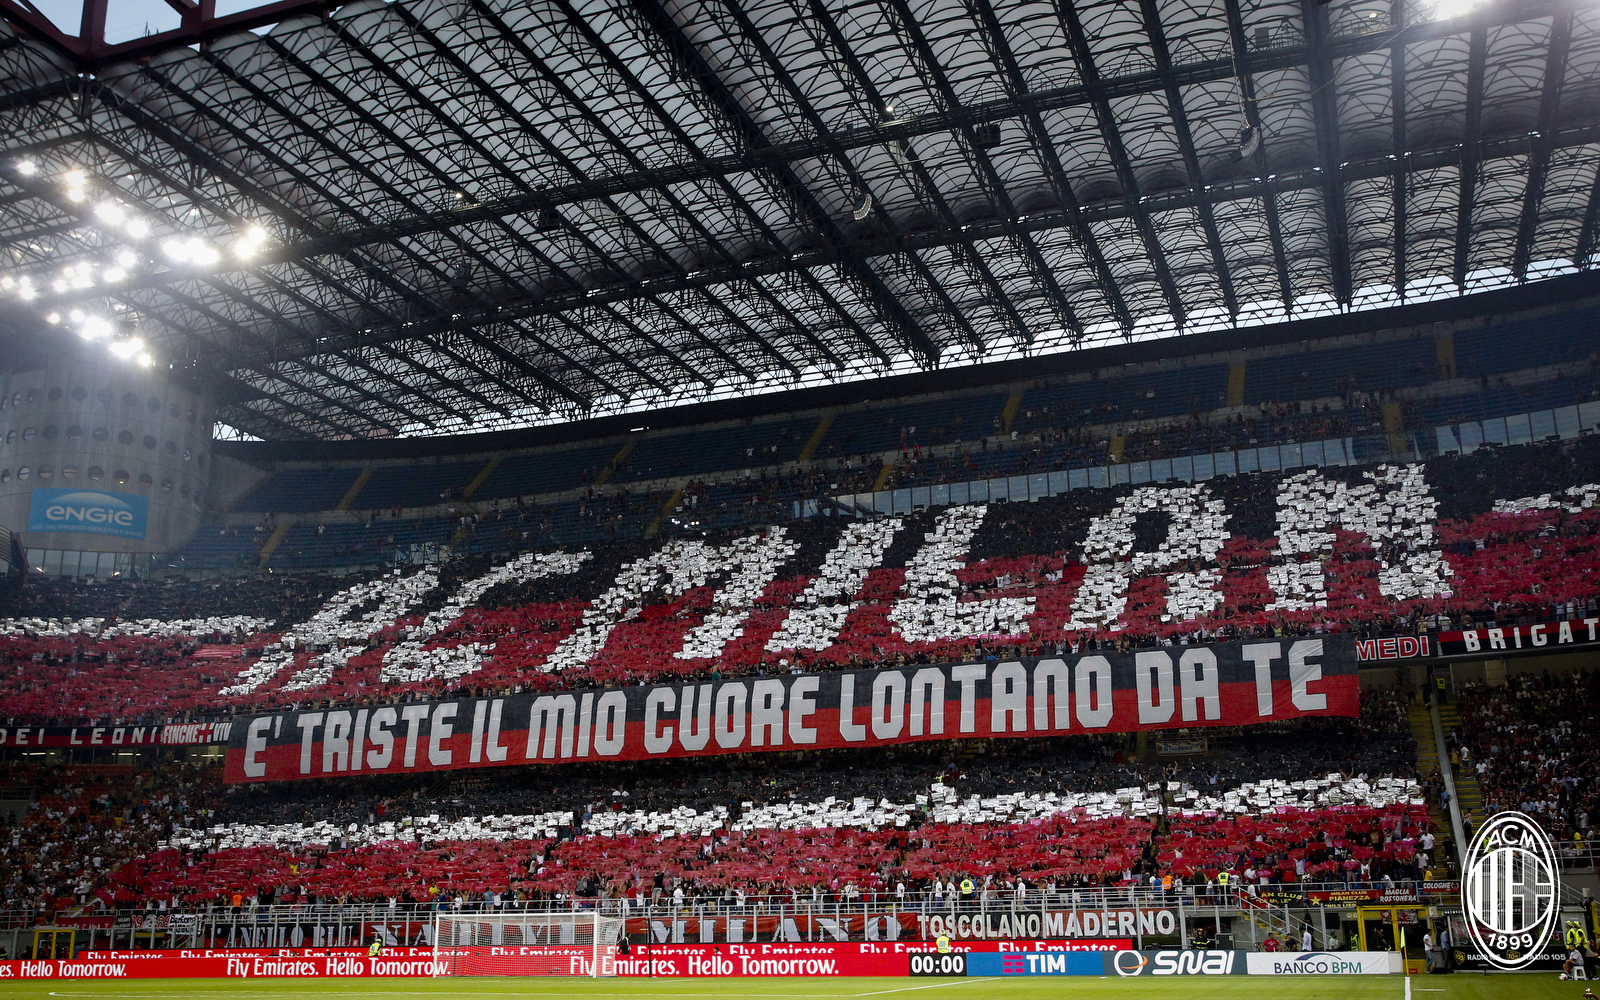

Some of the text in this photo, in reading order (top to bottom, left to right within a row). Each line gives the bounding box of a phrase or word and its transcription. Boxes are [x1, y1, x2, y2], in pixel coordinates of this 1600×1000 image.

[1462, 617, 1600, 652] BRIGAT
[1356, 635, 1430, 662] MEDI
[297, 702, 459, 775] TRISTE
[469, 699, 508, 763] IL
[525, 690, 627, 759] MIO
[644, 675, 820, 754] CUORE
[839, 655, 1114, 742] LONTANO
[1135, 647, 1221, 725] DA
[1242, 638, 1327, 717] TE
[70, 726, 158, 745] LEONI
[1045, 910, 1175, 937] MADERNO
[278, 948, 362, 957] Fl Emrates
[409, 948, 470, 956] Emrates
[894, 943, 971, 953] Emirtes
[1551, 953, 1567, 961] 105
[20, 961, 53, 977] Hello
[58, 961, 127, 977] Tomorrow.
[227, 957, 451, 978] Fly Emirates. Hello Tomorrow.
[602, 955, 680, 975] Emirates.
[688, 956, 733, 975] Hello
[739, 955, 839, 975] Tomorrow.
[911, 955, 964, 974] 00:00
[1026, 954, 1066, 974] TIM
[1274, 962, 1362, 974] BANCO BPM
